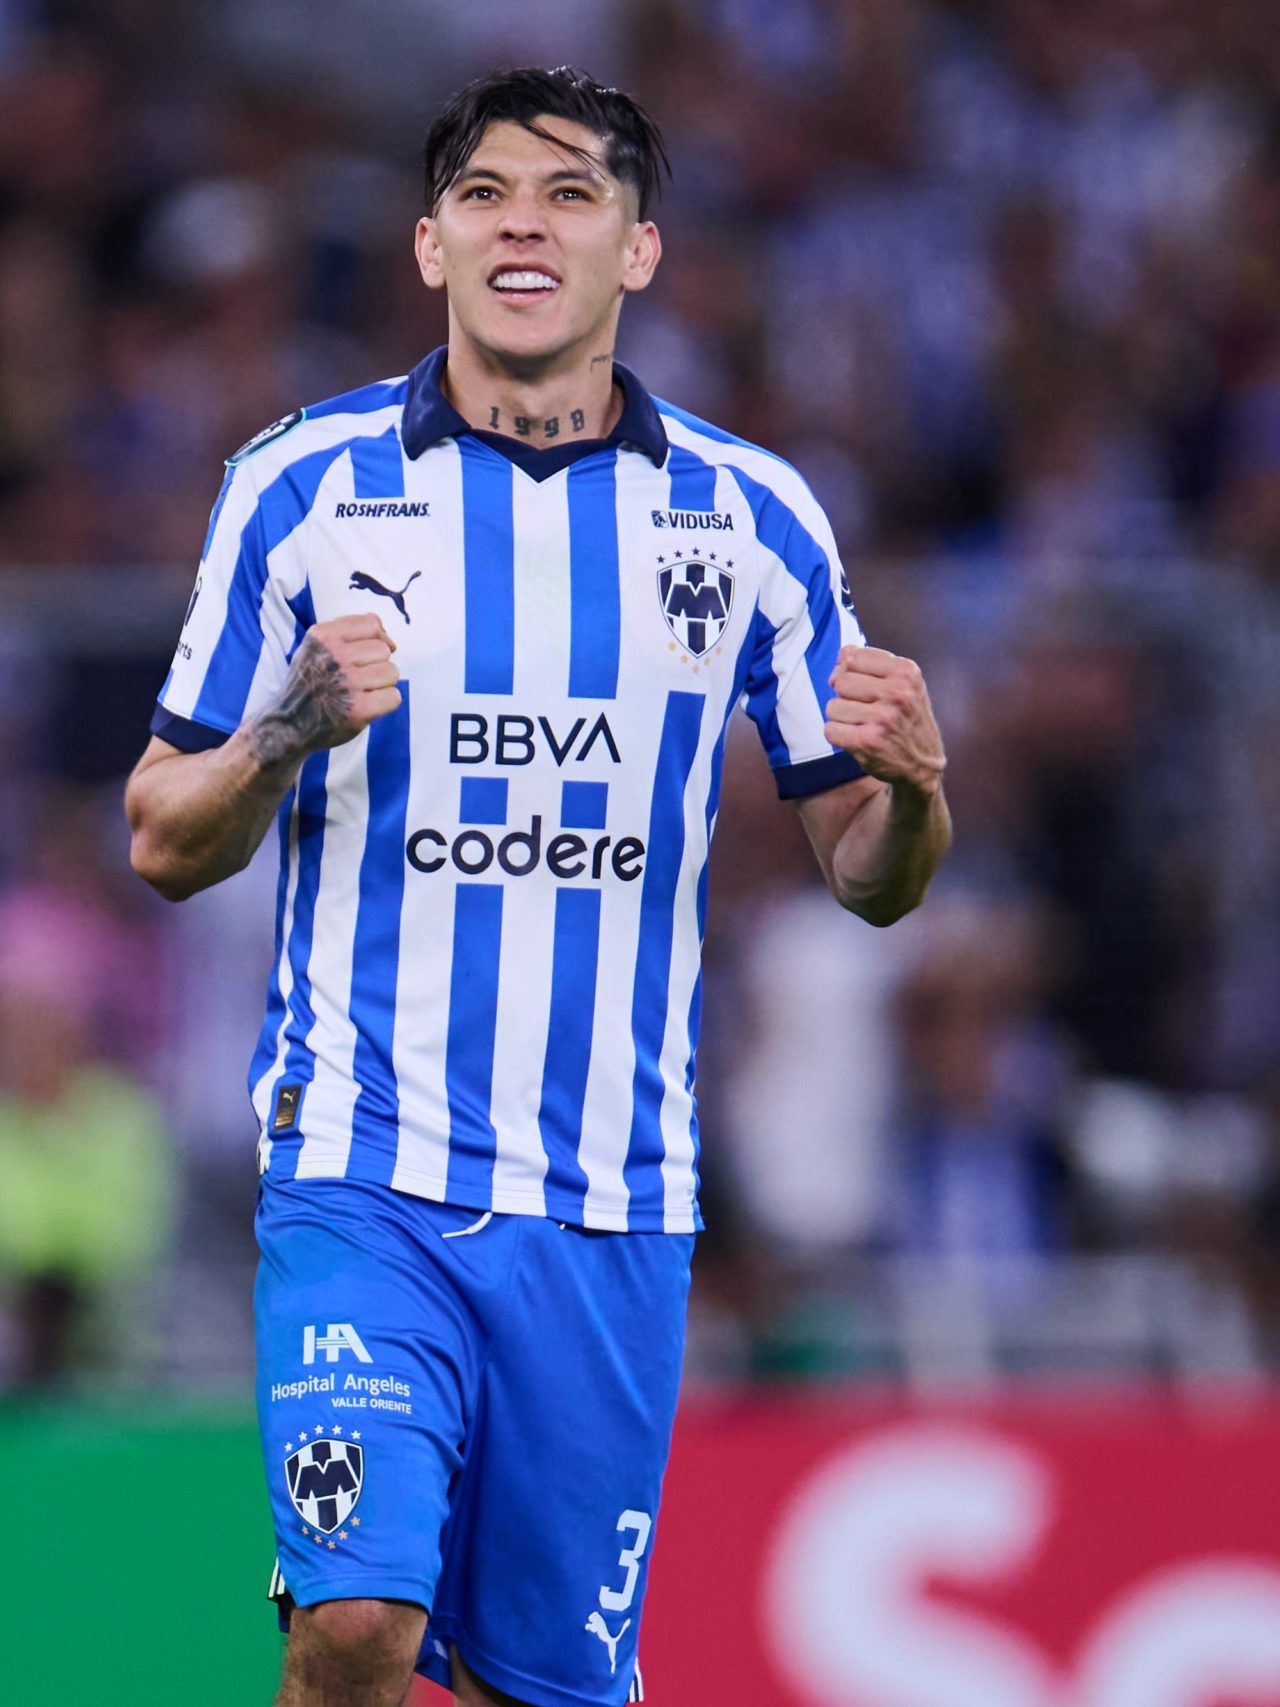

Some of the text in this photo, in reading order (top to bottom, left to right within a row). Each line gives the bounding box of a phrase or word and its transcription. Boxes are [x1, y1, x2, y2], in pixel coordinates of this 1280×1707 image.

[335, 503, 429, 518] ROSHFRANS
[668, 512, 734, 531] VIDUSA
[449, 712, 622, 767] BBVA
[406, 815, 646, 882] codere
[271, 1373, 411, 1402] Hospital Angeles
[331, 1397, 412, 1415] VALLE ORIENTE
[599, 1509, 651, 1611] 3
